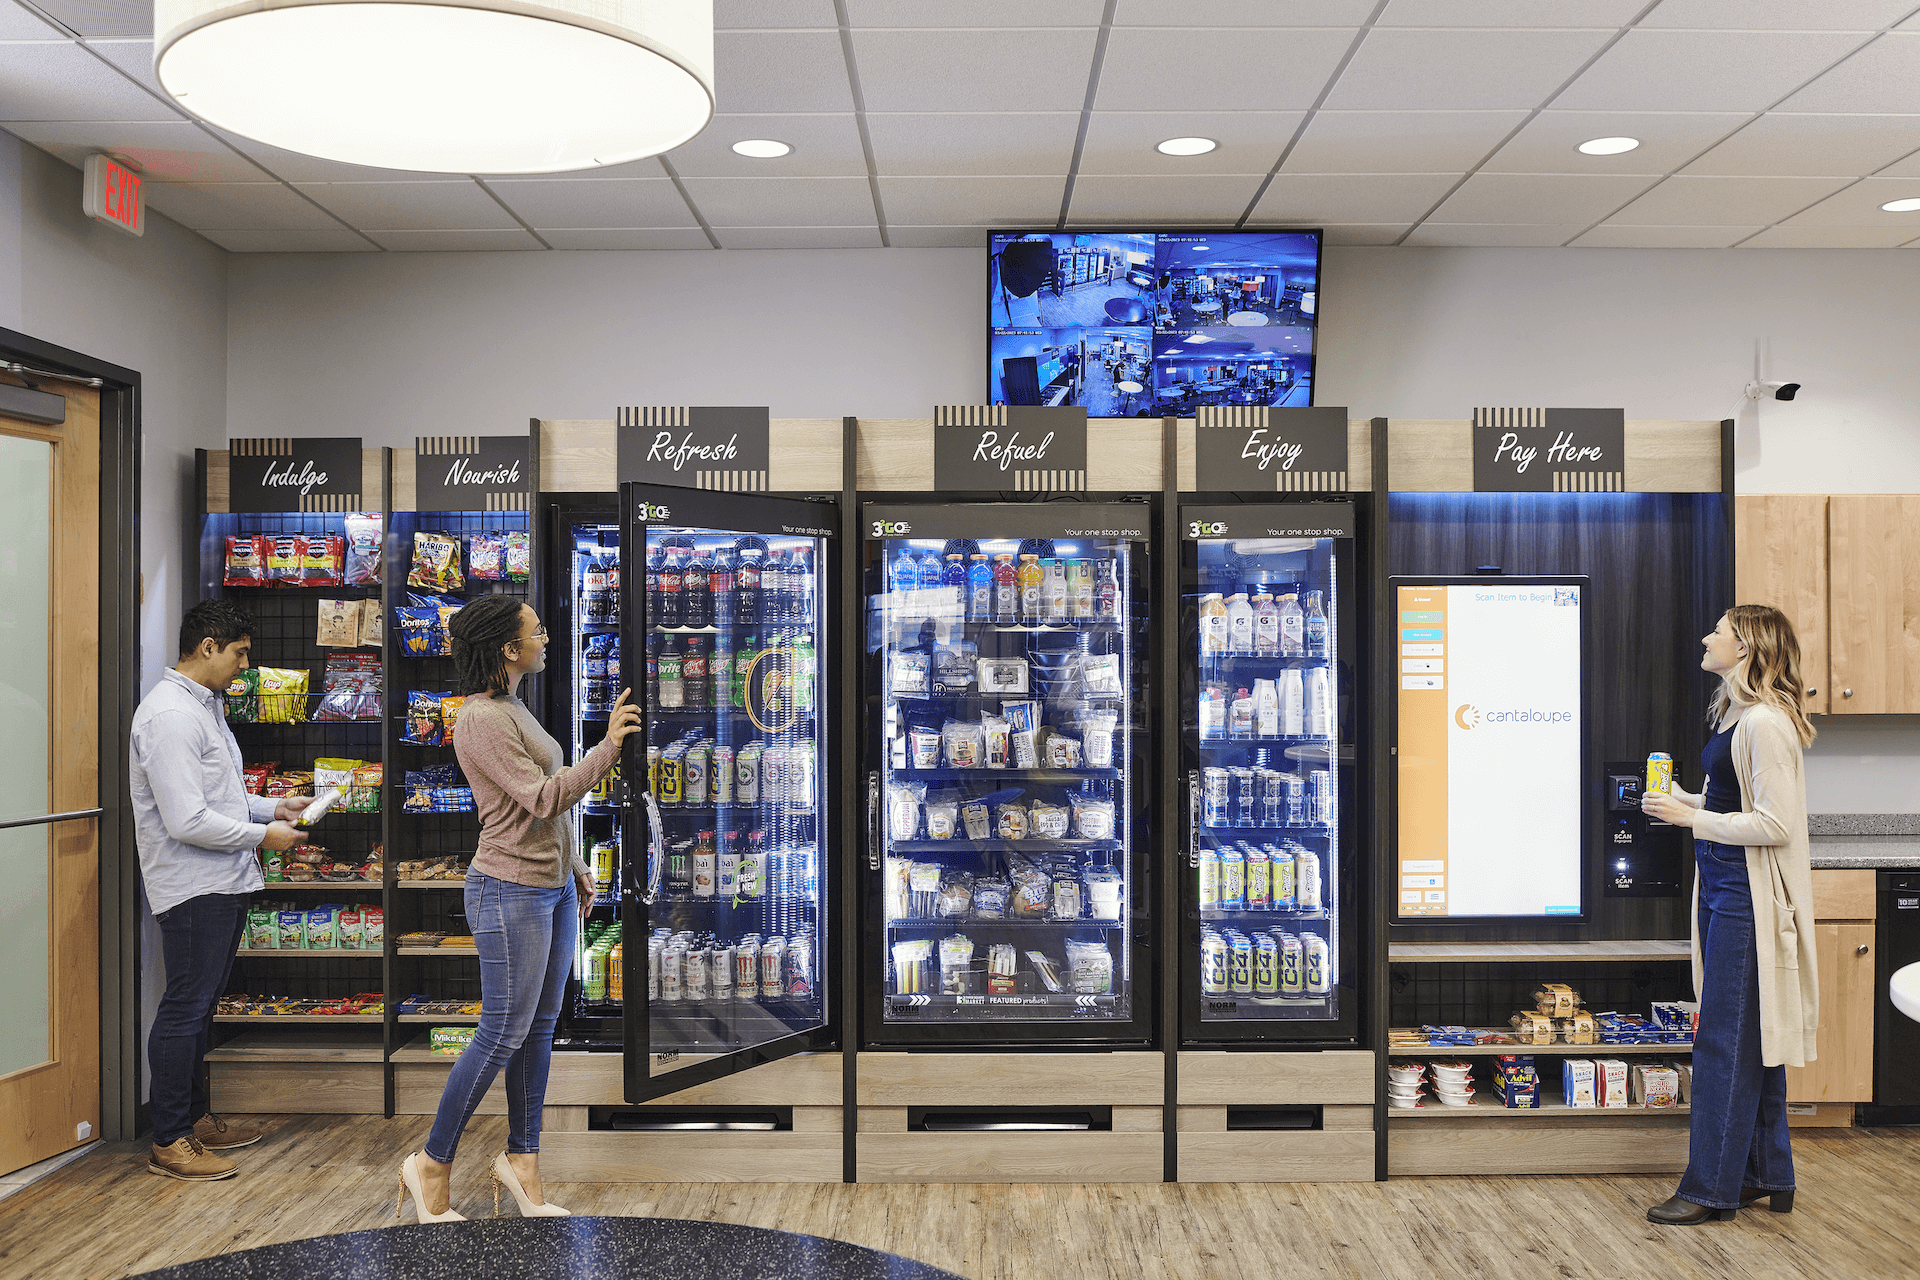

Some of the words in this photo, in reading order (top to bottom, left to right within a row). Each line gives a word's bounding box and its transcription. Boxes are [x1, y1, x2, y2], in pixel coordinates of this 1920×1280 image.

[105, 161, 141, 229] EXIT
[646, 431, 737, 469] Refresh
[972, 431, 1055, 471] Refuel
[1241, 429, 1303, 471] Enjoy
[1494, 432, 1538, 473] Pay
[1546, 432, 1603, 463] Here
[262, 460, 329, 494] Indulge
[444, 459, 520, 486] Nourish
[819, 528, 833, 536] shop.
[1324, 528, 1344, 536] shop.
[419, 541, 450, 552] HARIBO
[588, 576, 604, 584] oke
[1475, 593, 1495, 601] Scan
[1498, 593, 1517, 601] Item
[1530, 593, 1552, 603] Begin
[401, 618, 430, 627] Doritos
[414, 699, 442, 708] Doritos
[1486, 708, 1572, 725] cantaloupe
[663, 762, 677, 795] C4
[902, 803, 910, 834] PEPPERONI
[737, 873, 755, 883] FRESH
[735, 885, 741, 893] &
[742, 882, 756, 891] NEW
[1024, 887, 1048, 899] BIG
[1028, 894, 1046, 905] AZ
[1213, 953, 1225, 985] C4
[1235, 953, 1248, 985] C4
[1259, 953, 1271, 985] C4
[1284, 953, 1297, 985] C4
[1309, 953, 1321, 985] C4
[1023, 995, 1049, 1005] products!
[434, 1034, 456, 1042] Mike
[458, 1035, 472, 1043] Ike
[657, 1048, 679, 1061] NORM
[1511, 1074, 1532, 1082] Advil
